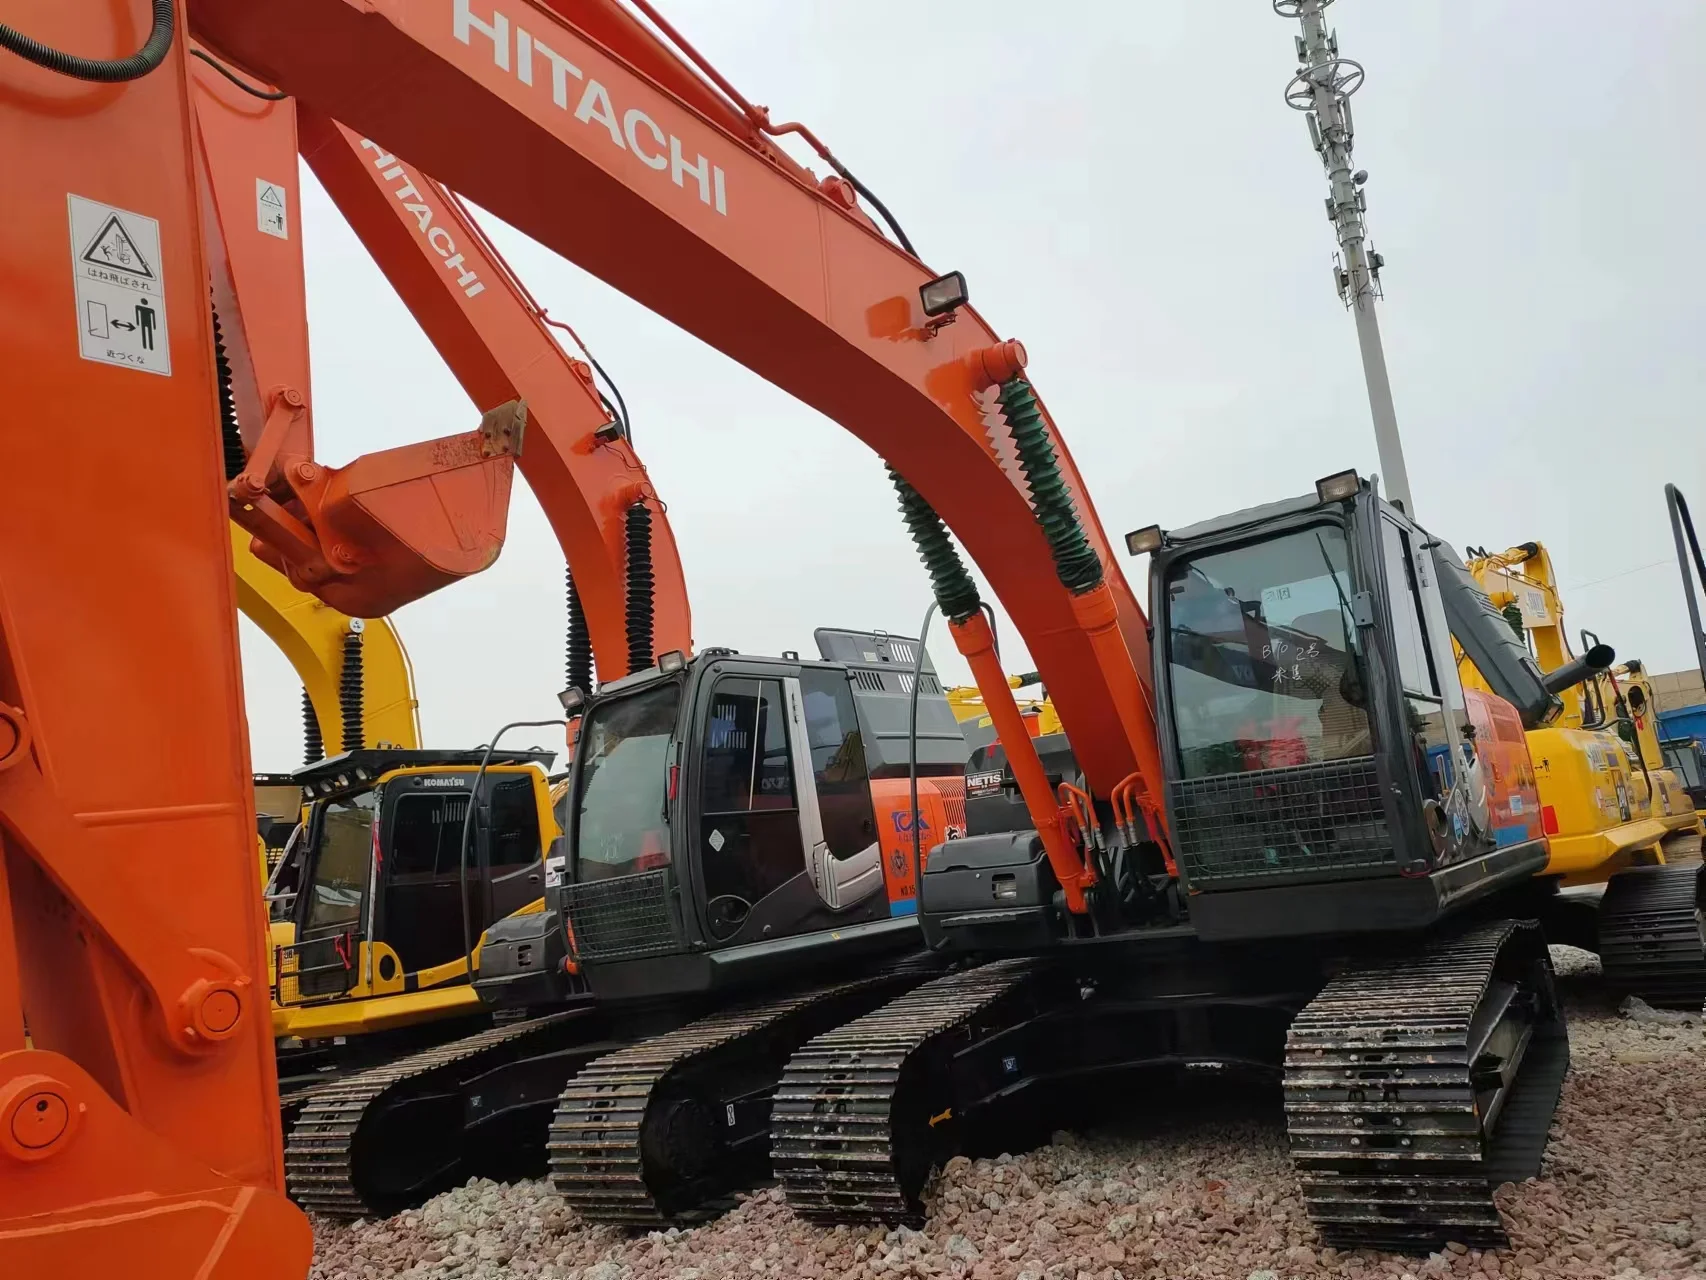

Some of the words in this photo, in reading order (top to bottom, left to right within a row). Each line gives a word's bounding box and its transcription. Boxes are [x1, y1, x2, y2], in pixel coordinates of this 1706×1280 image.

[453, 0, 727, 216] HITACHI
[359, 138, 486, 298] HITACHI
[87, 267, 151, 291] はね飛ばされ
[106, 349, 145, 364] 近づくな
[424, 777, 465, 787] KOMATSU
[967, 774, 1002, 788] NETIS
